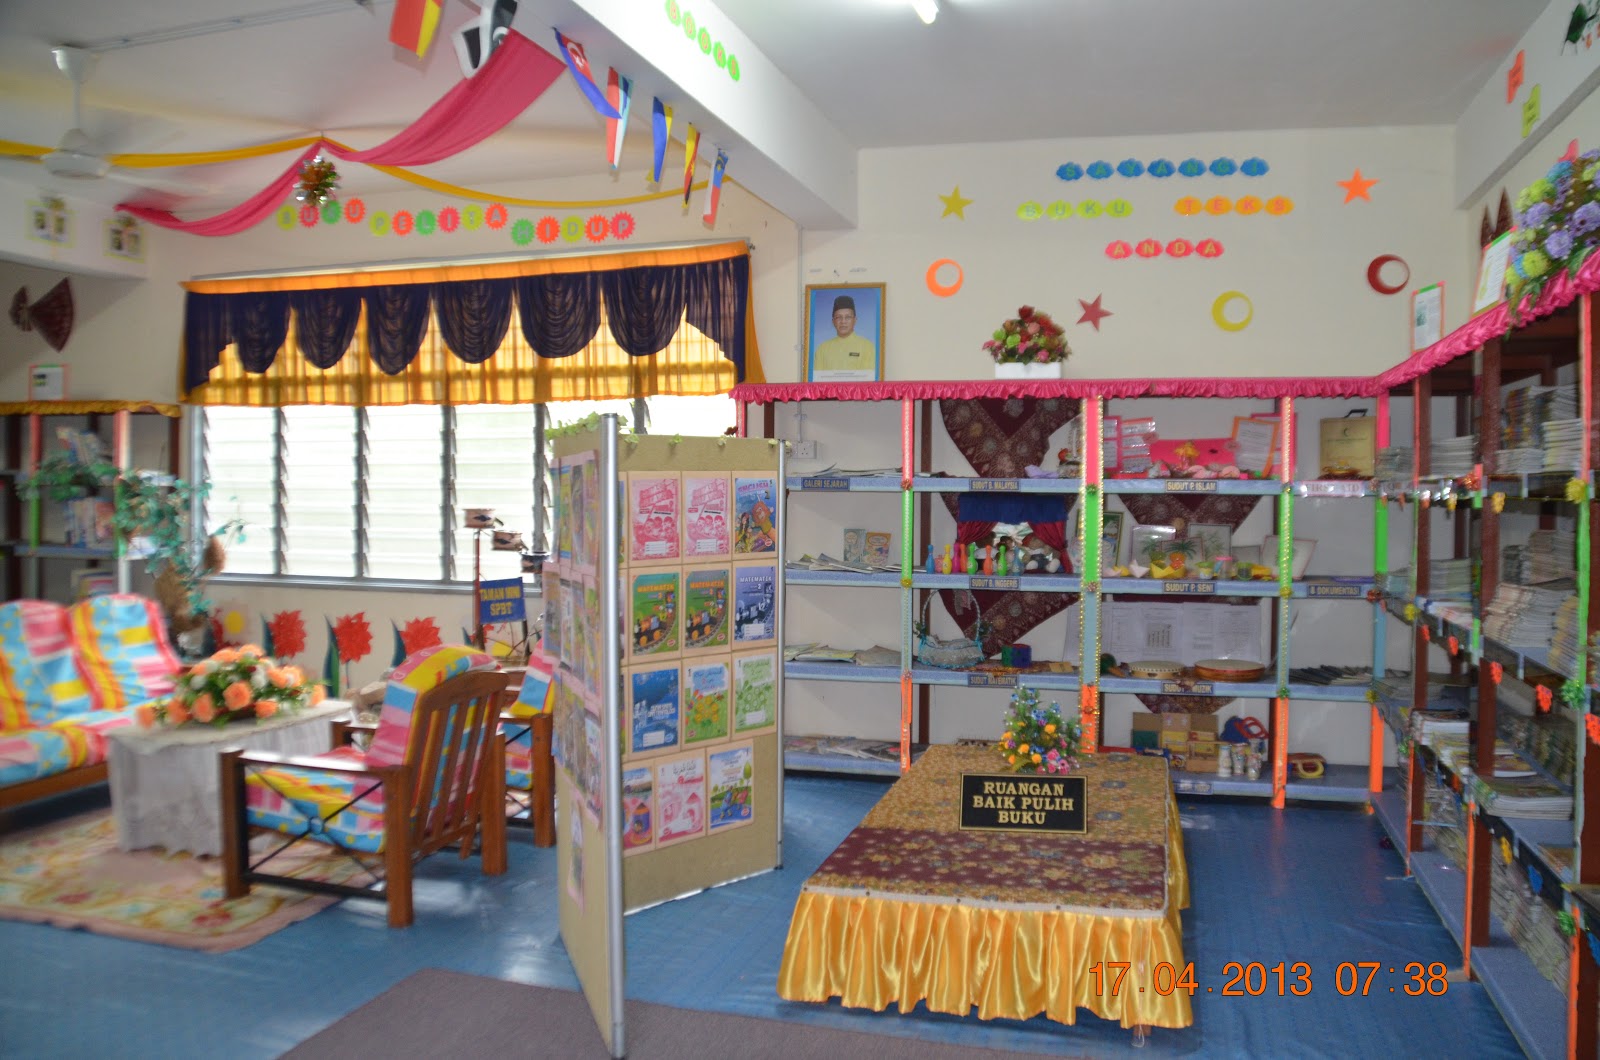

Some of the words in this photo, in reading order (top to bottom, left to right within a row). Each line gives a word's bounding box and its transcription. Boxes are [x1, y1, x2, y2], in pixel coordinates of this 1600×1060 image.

[1063, 158, 1261, 178] SAYANGI
[1024, 200, 1127, 217] BUKU
[1182, 198, 1287, 214] TEKS
[374, 205, 503, 230] PELITA
[515, 218, 630, 241] HIDUP
[1112, 240, 1218, 257] ANDA
[803, 479, 822, 488] GALERI
[823, 479, 848, 488] SEJARAH
[972, 481, 988, 489] SUDUT
[994, 481, 1018, 489] MALAYSIA
[1167, 481, 1188, 490] SUDUT
[1189, 482, 1194, 490] P.
[1195, 482, 1216, 490] ISLAM
[1341, 483, 1360, 492] AID
[739, 575, 772, 583] MATEMATIK
[971, 579, 988, 587] SUDUT
[994, 579, 1018, 588] INGGERIS
[637, 583, 675, 592] MATEMATIK
[690, 580, 725, 589] MATEMATIK
[1165, 583, 1189, 592] SUDUT
[1190, 583, 1196, 592] P.
[1197, 583, 1215, 592] SENI
[479, 588, 504, 601] TAMAN
[1317, 586, 1360, 595] DOKUMENTASI
[490, 602, 512, 616] SPBT
[970, 675, 987, 685] SUDUT
[988, 676, 1016, 686] MATEMATIK
[1192, 684, 1212, 693] MUZIK
[983, 781, 1064, 796] RUANGAN
[973, 795, 1016, 809] BAIK
[1021, 797, 1074, 811] PULIH
[998, 811, 1046, 824] BUKU
